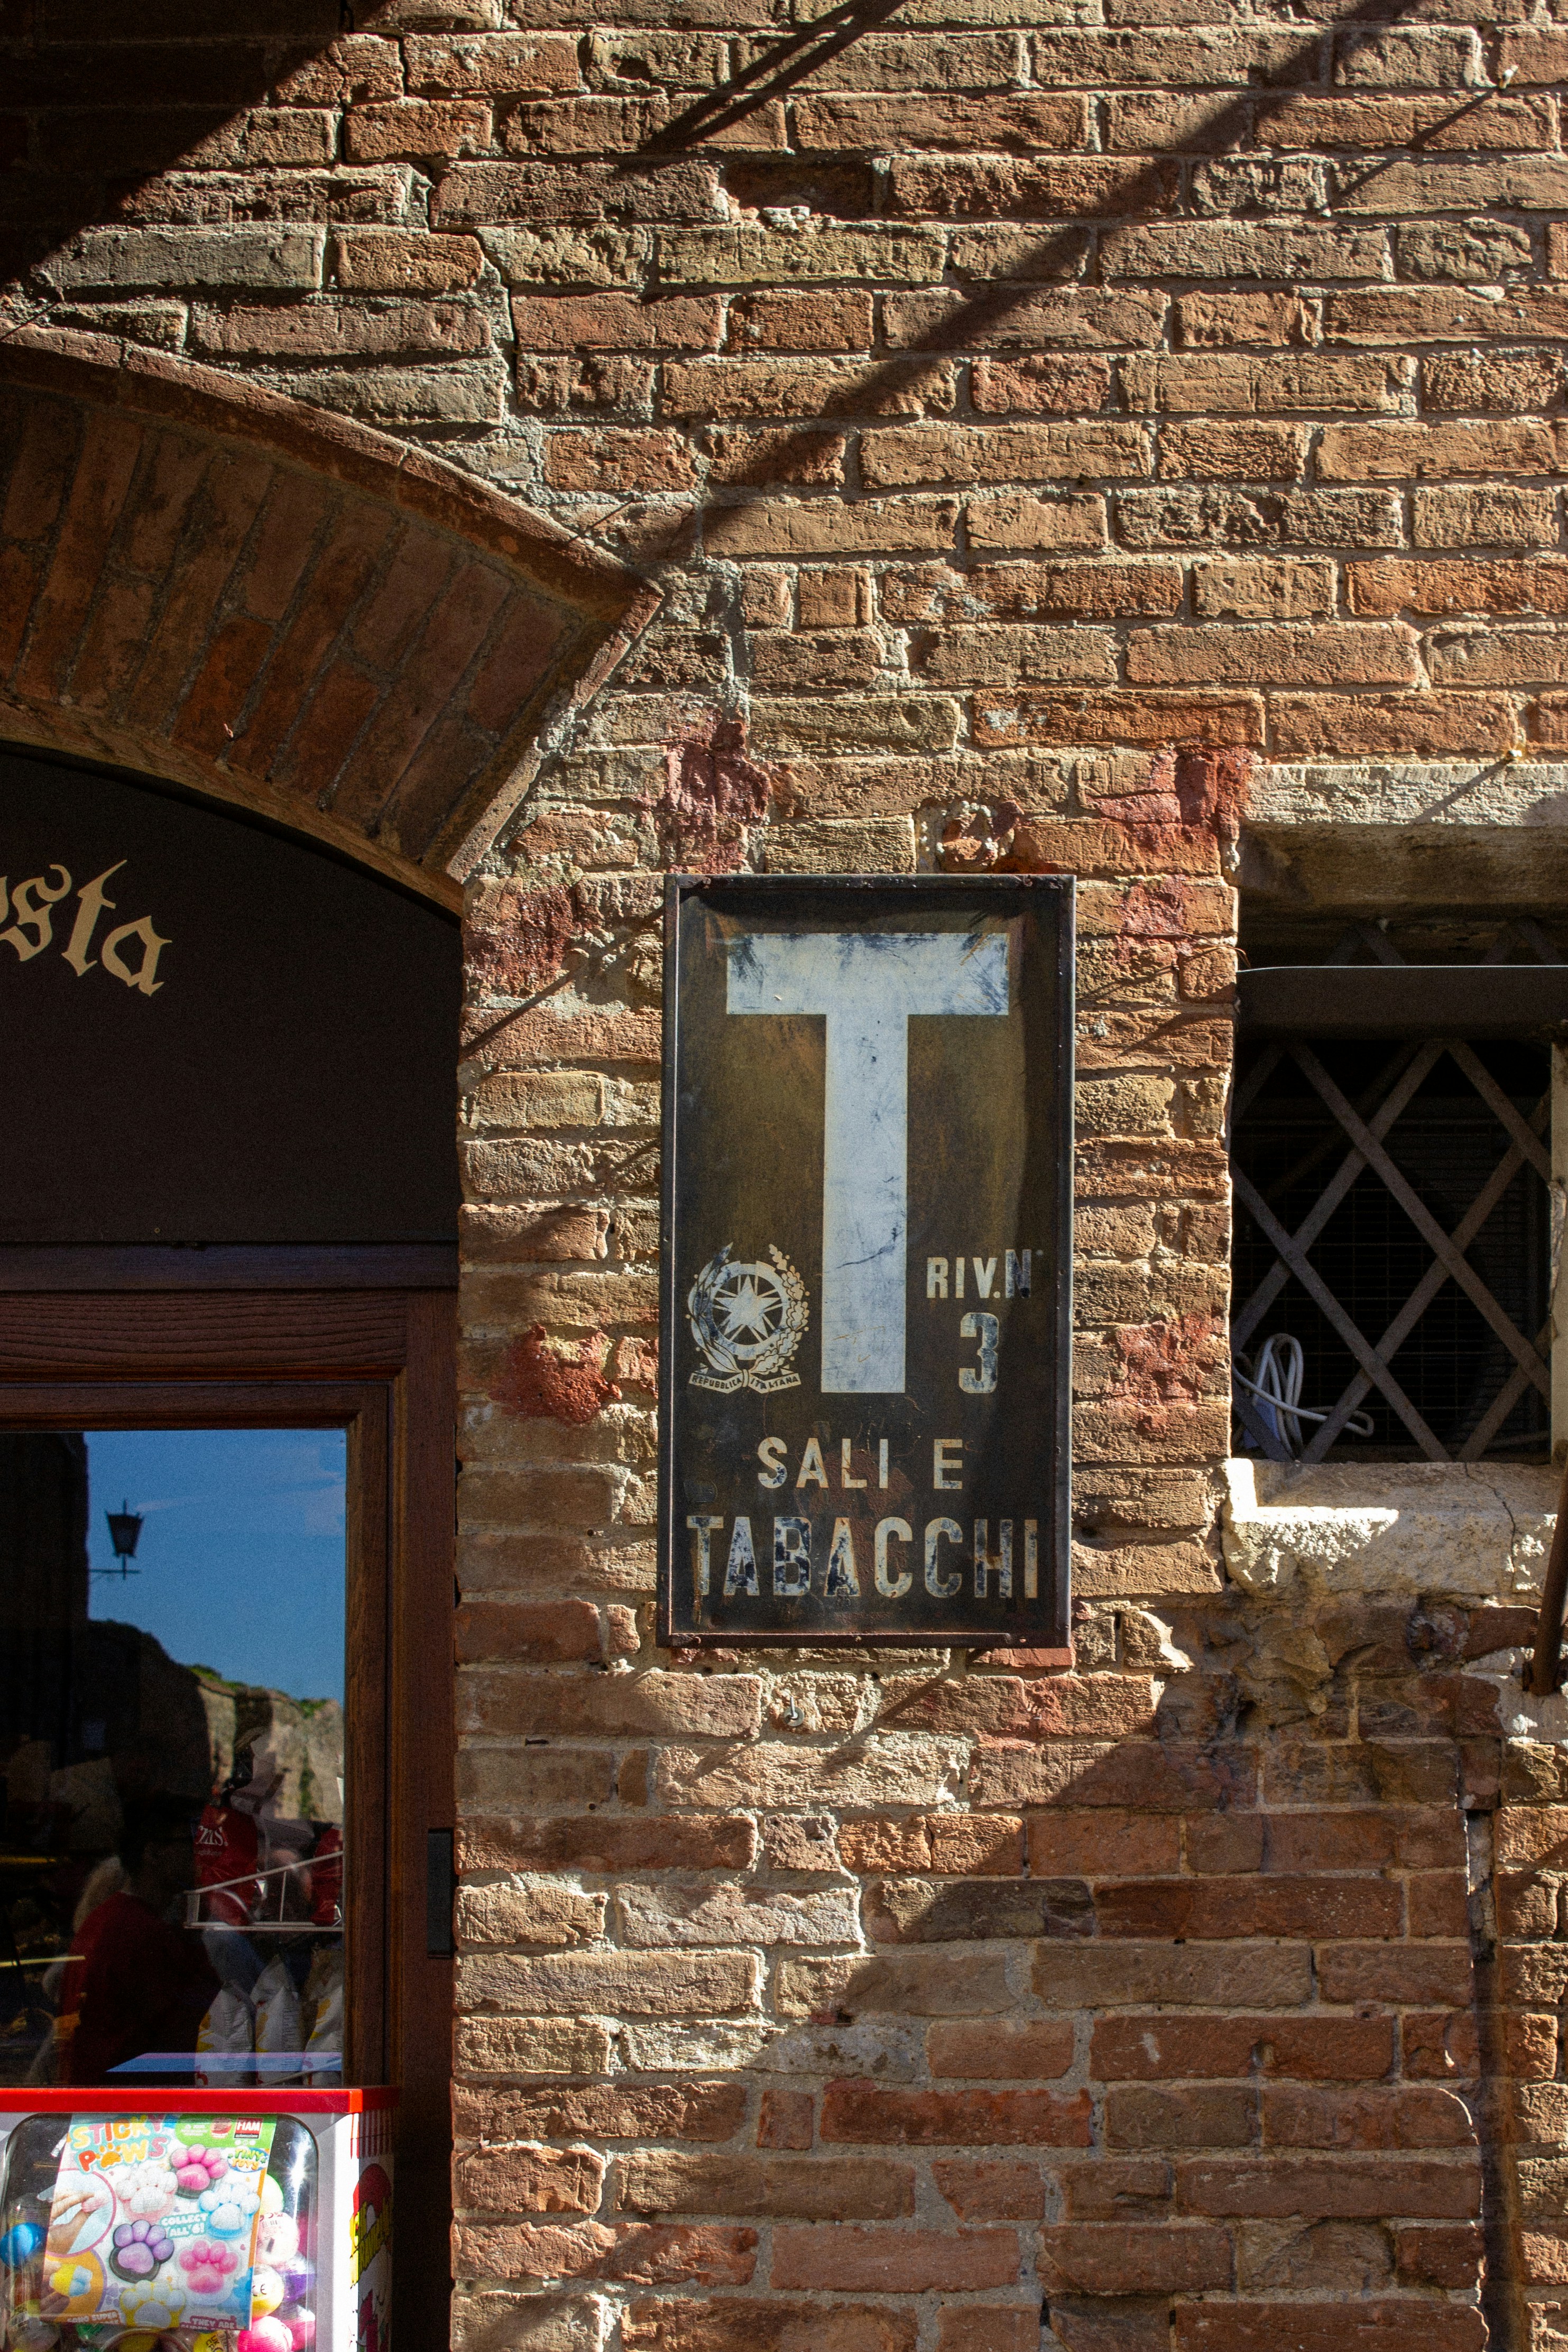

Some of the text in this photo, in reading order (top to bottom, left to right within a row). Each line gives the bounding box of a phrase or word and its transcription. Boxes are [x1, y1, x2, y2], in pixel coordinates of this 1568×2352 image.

[726, 932, 1009, 1393] T
[958, 1312, 1000, 1394] 3
[692, 1375, 742, 1389] REPUBBLICA
[757, 1436, 963, 1489] SALI E
[687, 1516, 1038, 1598] TABACCHI
[73, 2115, 165, 2148] STICKY
[235, 2148, 264, 2162] TINY
[161, 2213, 208, 2226] COLLECT
[170, 2227, 189, 2237] ALL
